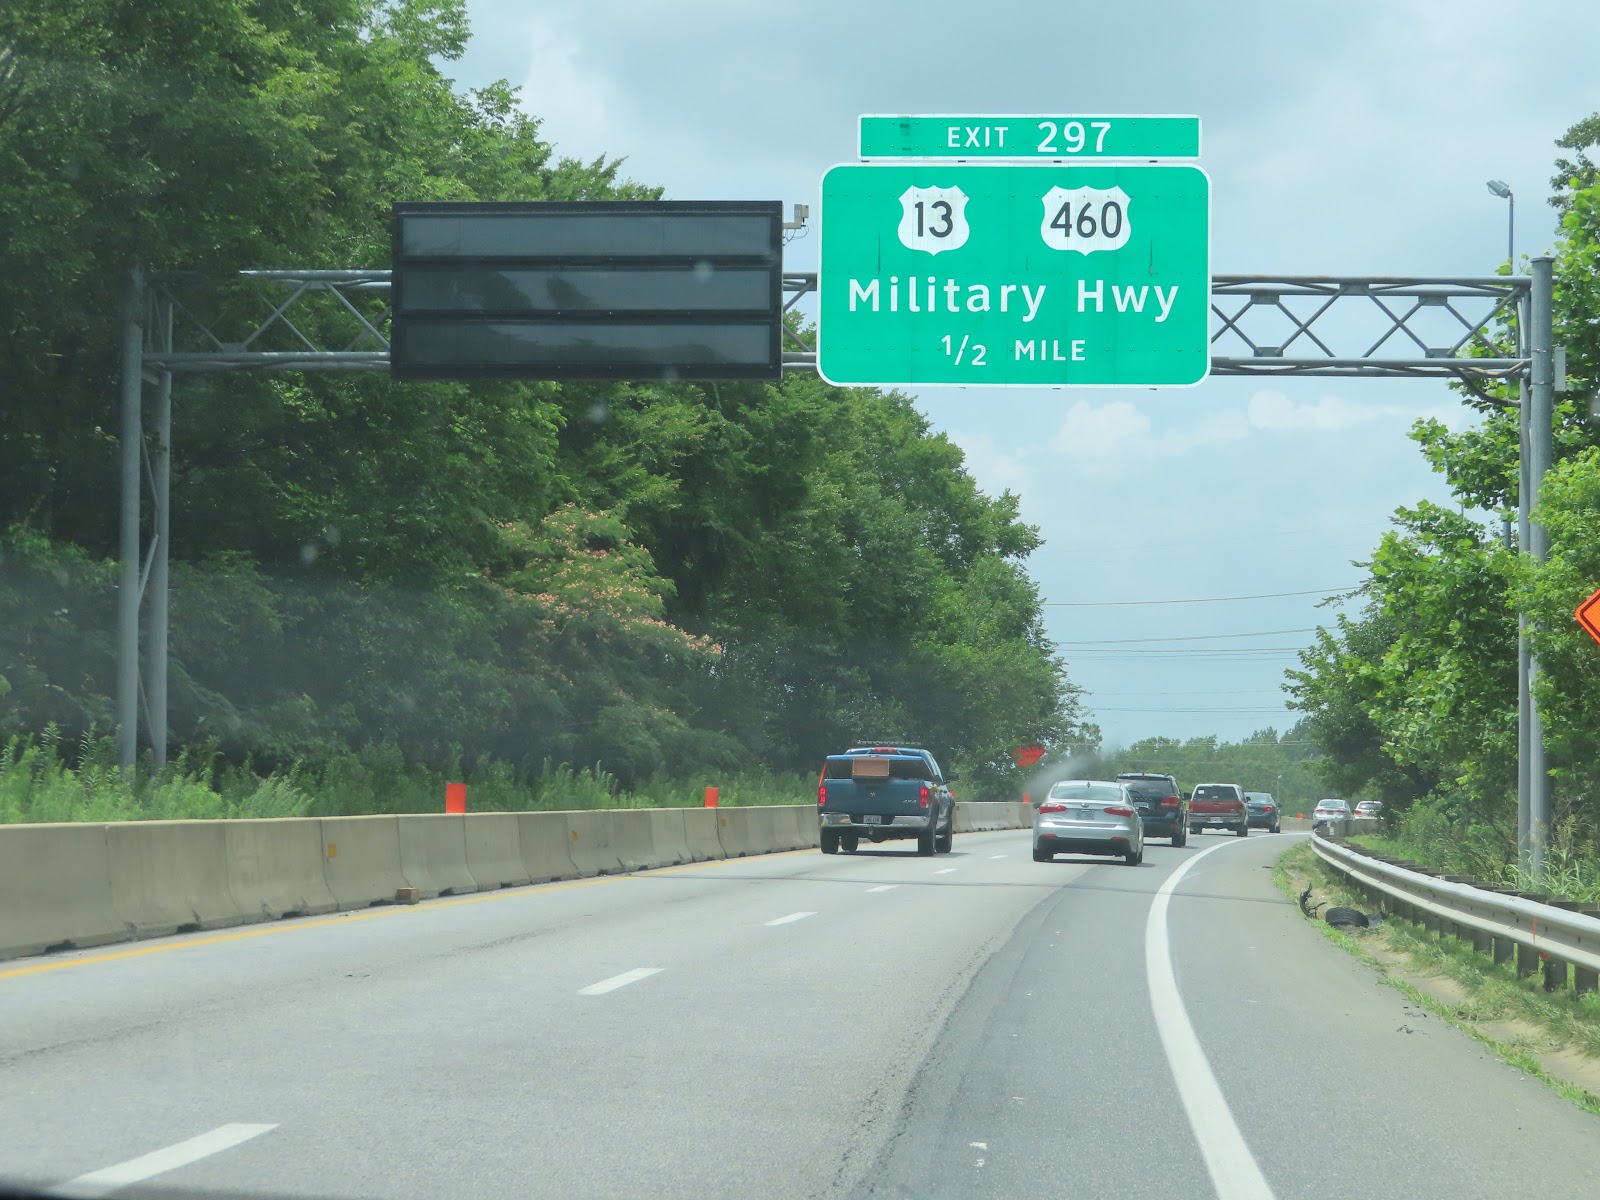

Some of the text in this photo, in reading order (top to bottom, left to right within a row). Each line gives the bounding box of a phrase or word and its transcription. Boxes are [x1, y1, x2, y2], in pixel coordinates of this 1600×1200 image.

[947, 121, 1112, 153] EXIT 297
[914, 200, 954, 239] 13
[1049, 200, 1123, 239] 460
[848, 275, 1179, 323] Military Hwy
[940, 334, 1086, 366] 1/2 MILE
